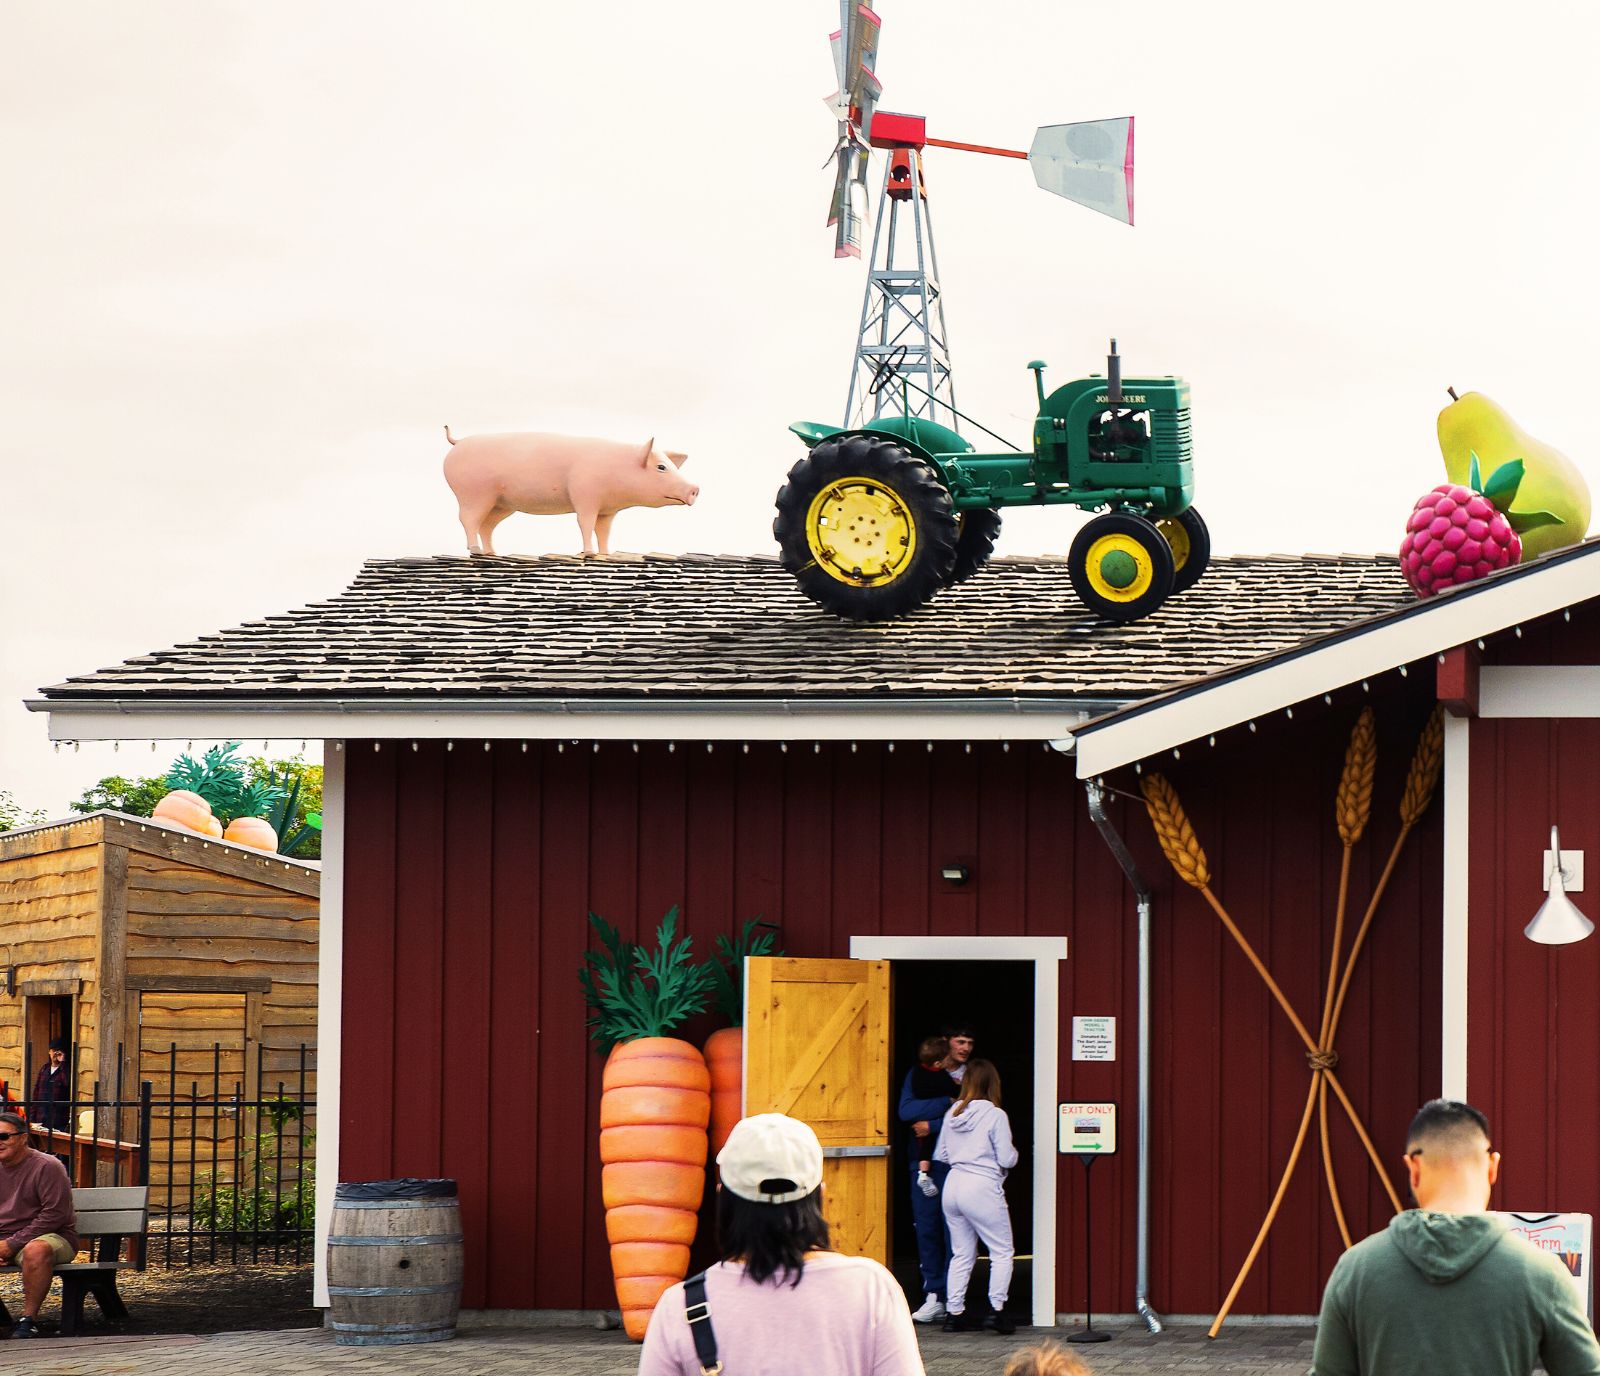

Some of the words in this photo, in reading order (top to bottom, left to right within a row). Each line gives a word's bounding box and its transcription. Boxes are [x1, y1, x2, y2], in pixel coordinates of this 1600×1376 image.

[1061, 1106, 1083, 1114] EXIT
[1086, 1106, 1113, 1114] ONLY
[1523, 1225, 1568, 1252] Farm
